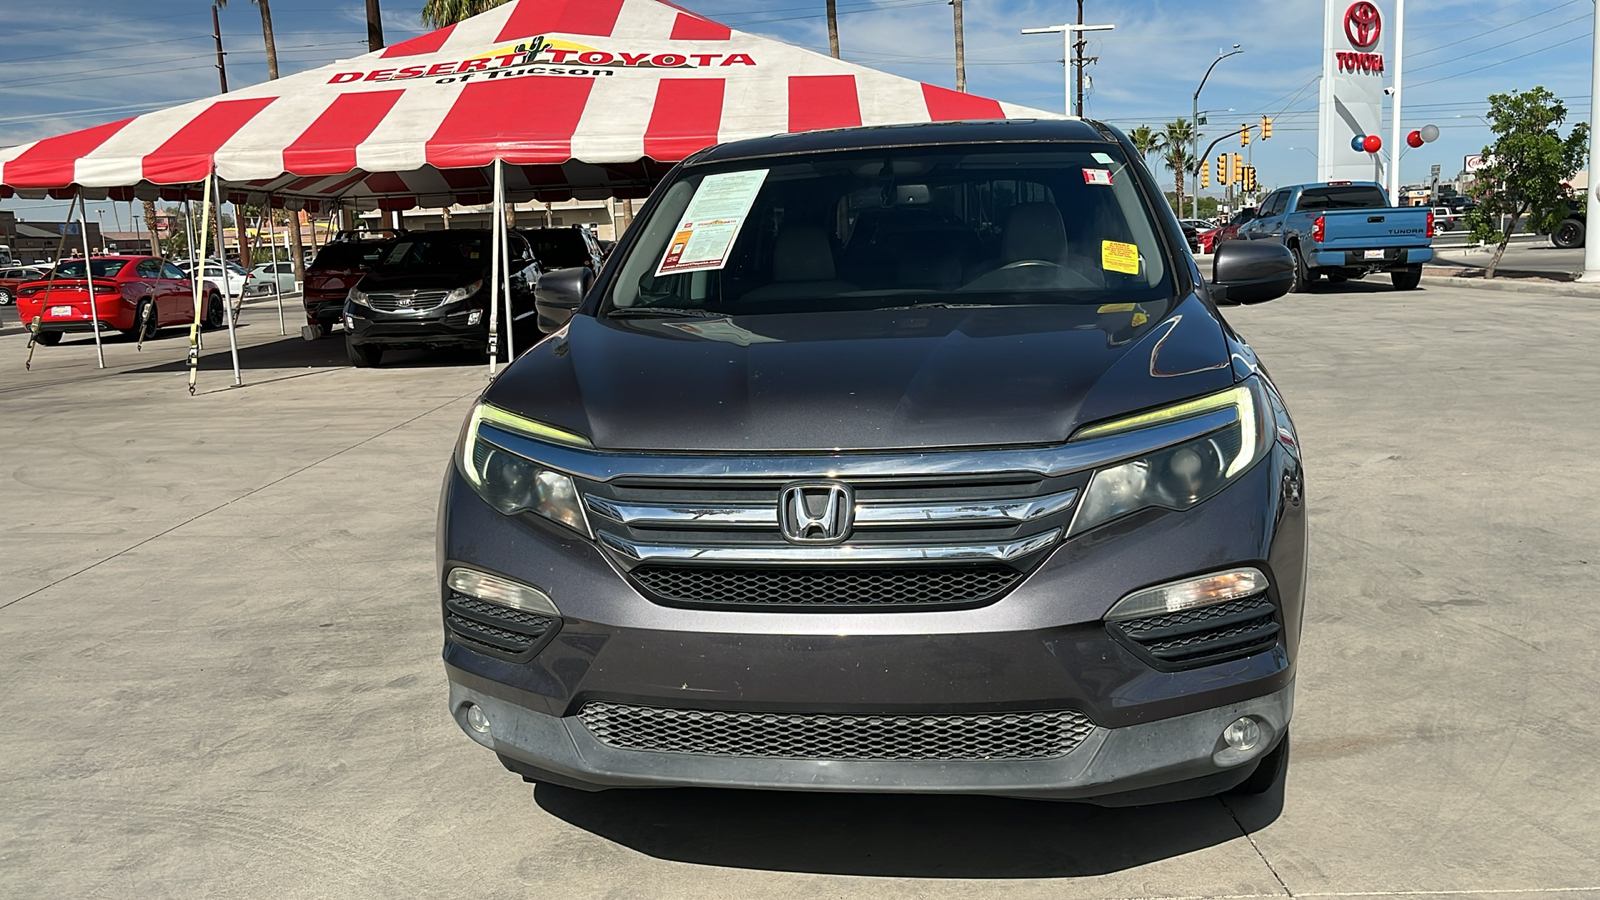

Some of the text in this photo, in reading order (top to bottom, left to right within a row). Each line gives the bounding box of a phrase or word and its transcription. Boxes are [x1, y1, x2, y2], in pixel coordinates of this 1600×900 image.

[326, 49, 756, 84] DESERT TOYOTA
[1335, 52, 1384, 71] TOYOTA
[435, 67, 614, 84] of Tucson
